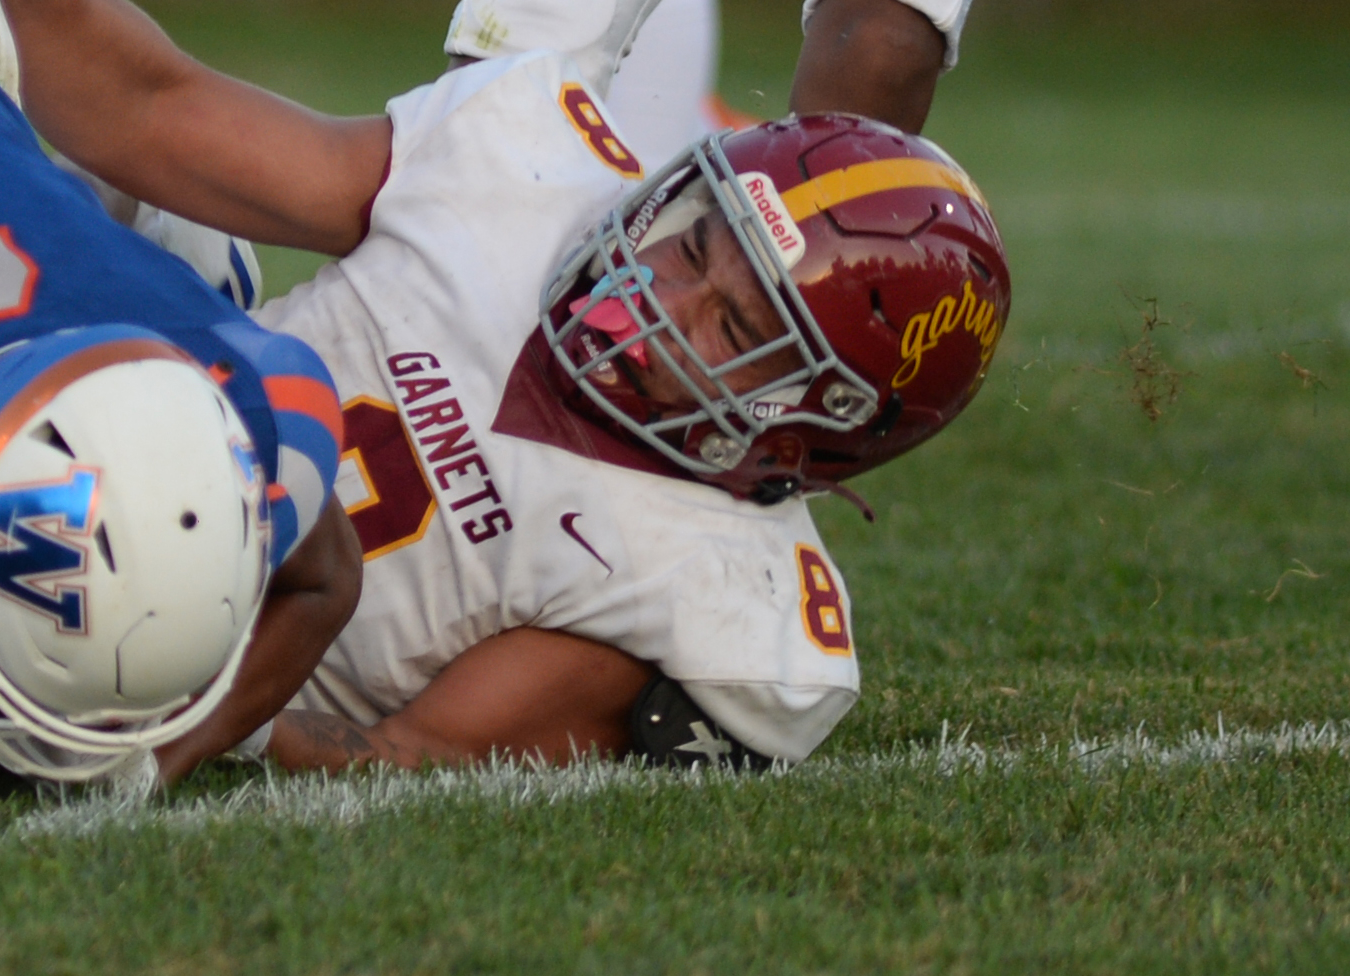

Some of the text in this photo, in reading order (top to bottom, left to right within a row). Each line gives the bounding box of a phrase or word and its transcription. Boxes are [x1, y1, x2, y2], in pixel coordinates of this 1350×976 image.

[557, 82, 644, 180] 8
[745, 177, 798, 252] Riddell
[386, 351, 514, 545] GARNETS
[794, 541, 852, 657] 8
